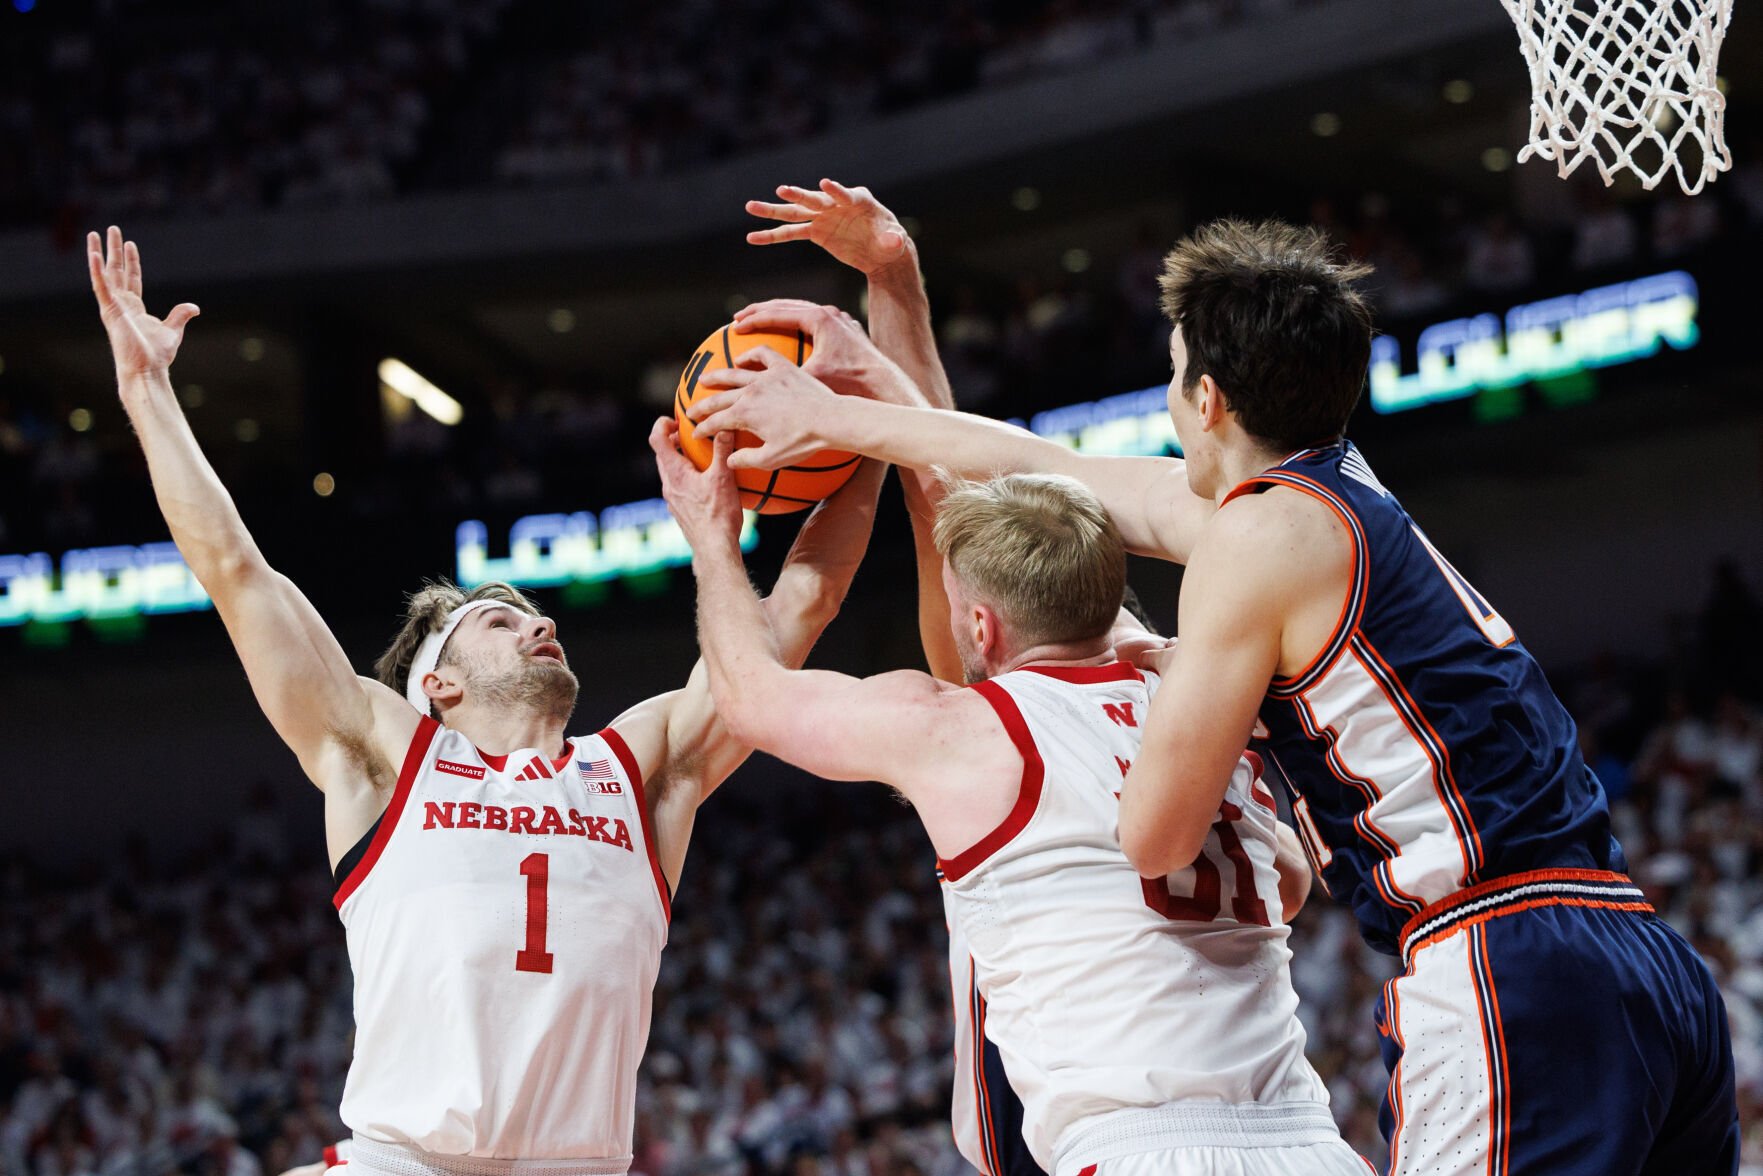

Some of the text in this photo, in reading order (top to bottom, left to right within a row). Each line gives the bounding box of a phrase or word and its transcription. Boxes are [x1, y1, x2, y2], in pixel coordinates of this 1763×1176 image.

[1101, 702, 1138, 728] N
[438, 763, 483, 777] GRADUATE
[422, 801, 634, 853] NEBRASKA
[516, 852, 554, 974] 1
